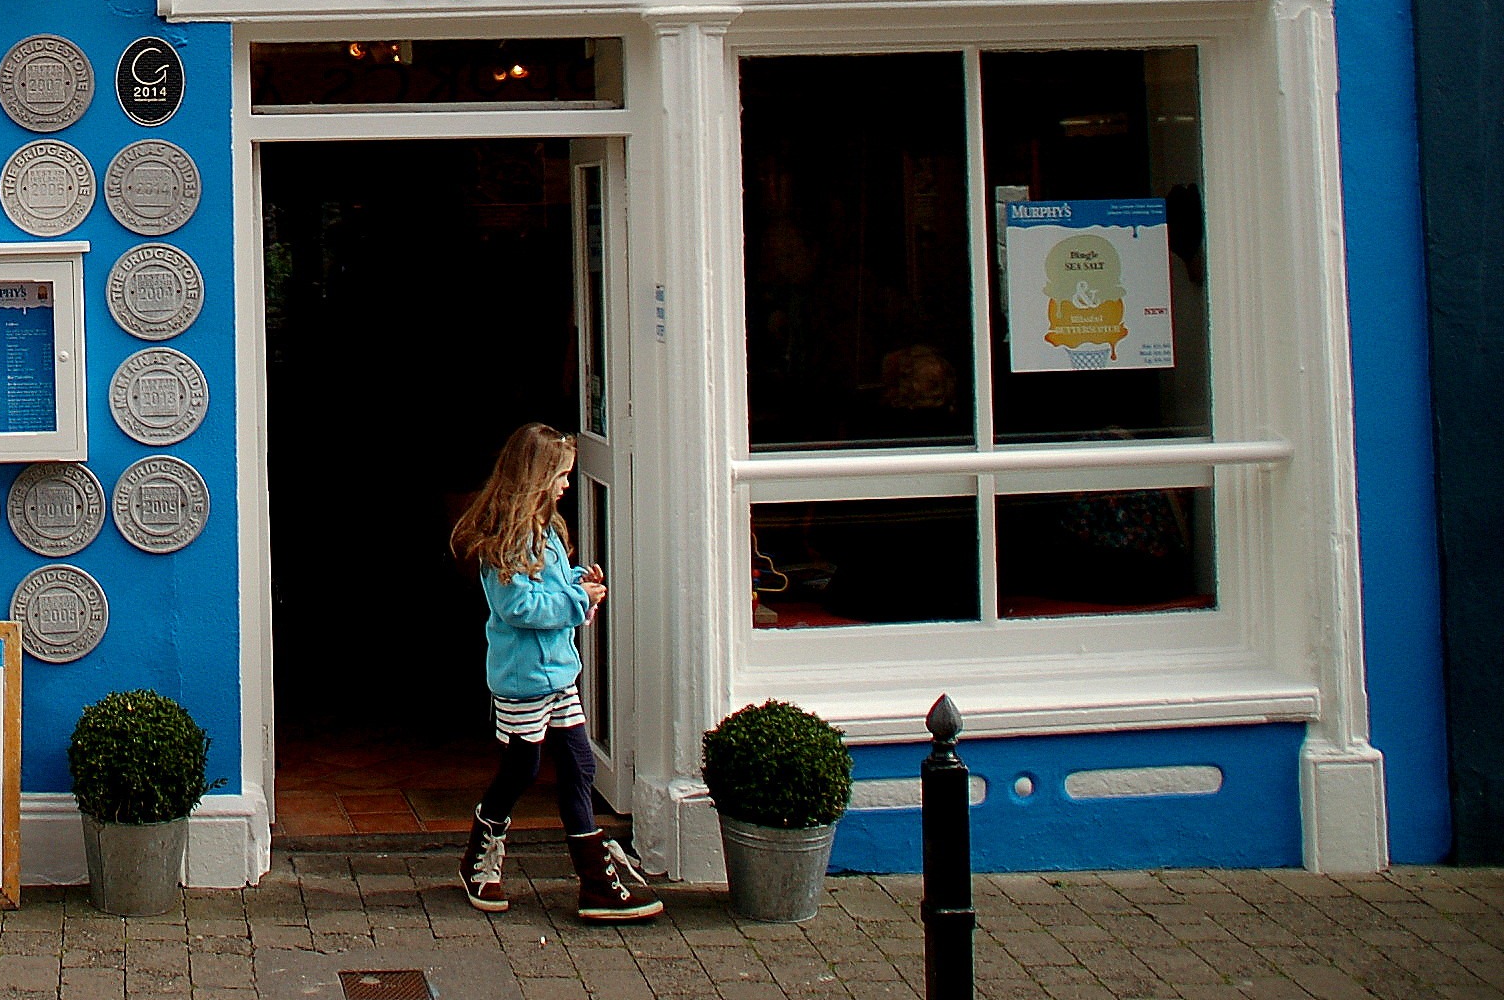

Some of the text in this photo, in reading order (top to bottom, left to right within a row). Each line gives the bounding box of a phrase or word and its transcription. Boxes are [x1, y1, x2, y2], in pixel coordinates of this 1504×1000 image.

[1, 60, 17, 93] THE
[134, 86, 167, 98] 2014
[3, 166, 19, 198] THE
[1011, 203, 1072, 218] MURPHY'S
[1070, 251, 1099, 260] Dingle
[1065, 262, 1105, 271] SEA SALT
[111, 269, 126, 301] THE
